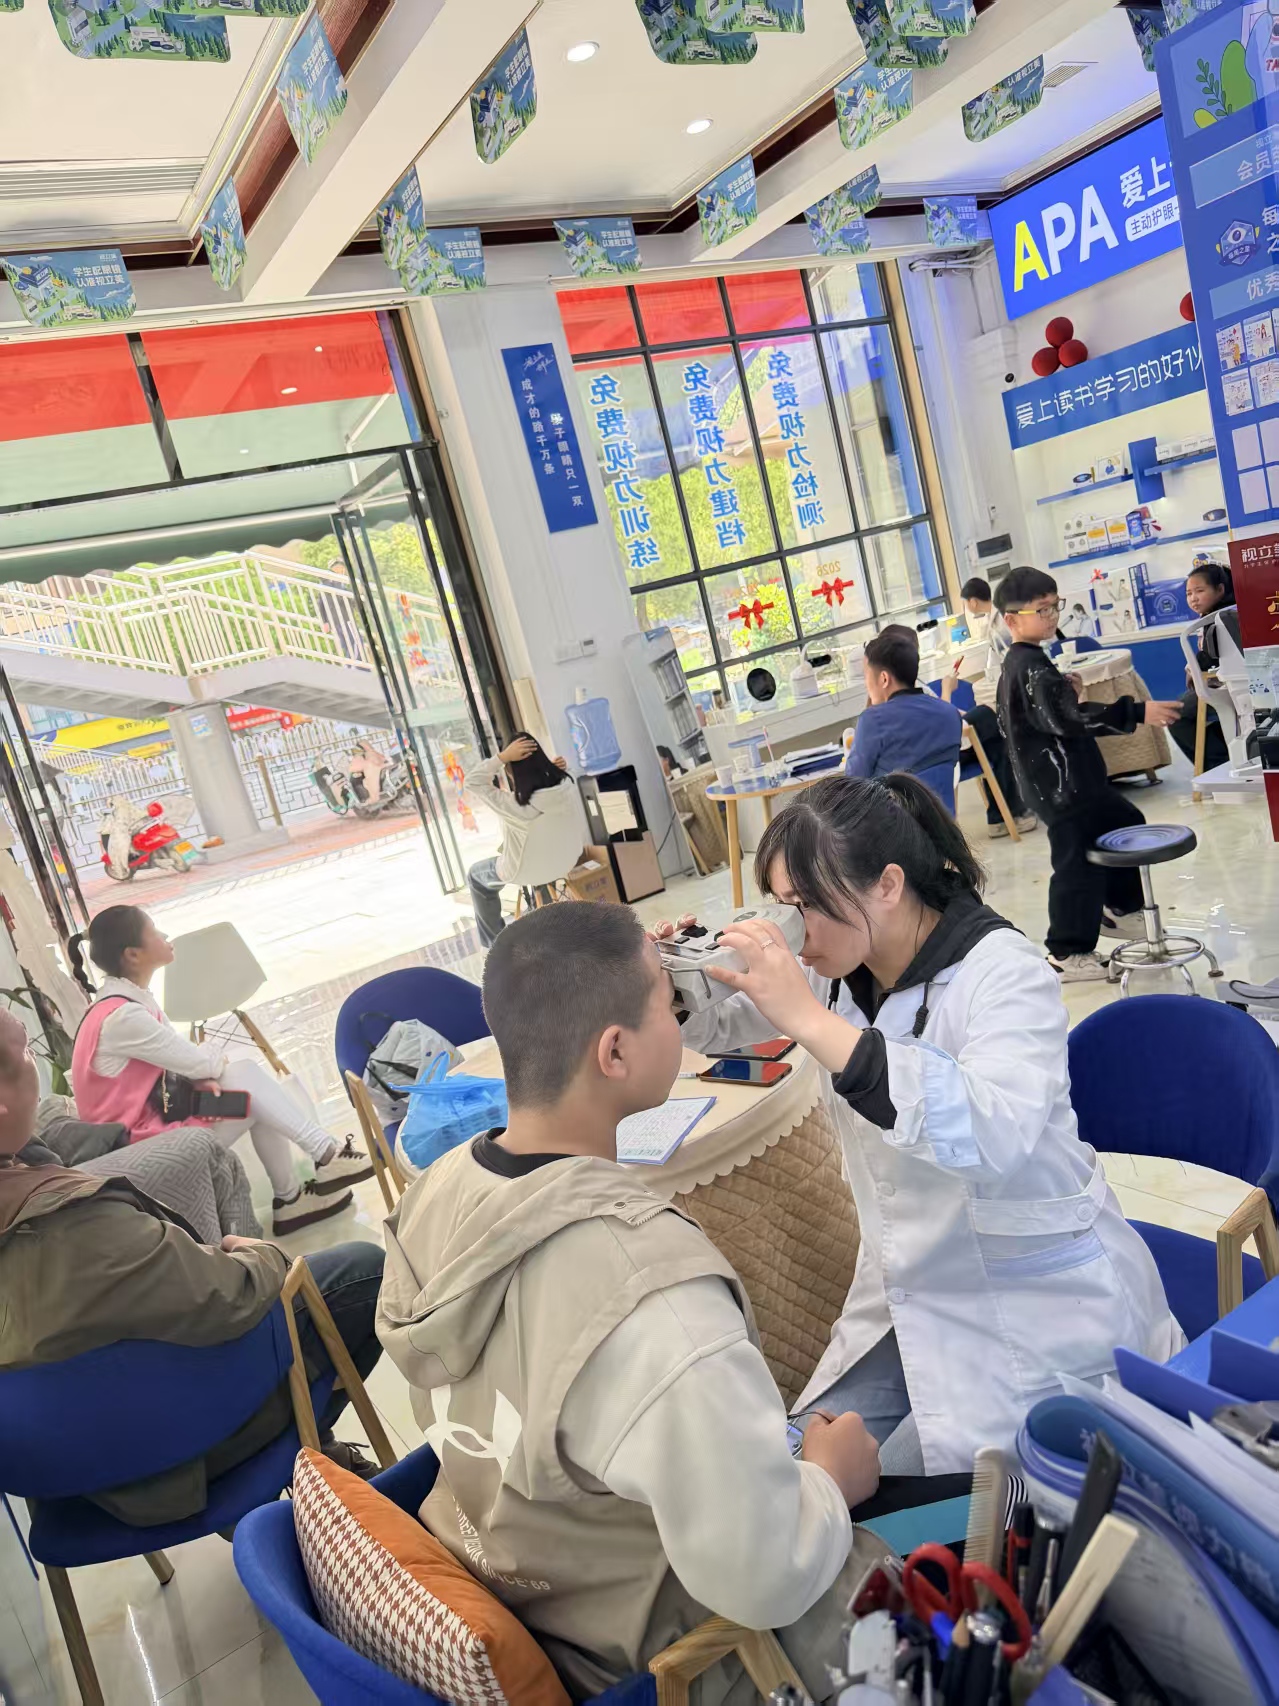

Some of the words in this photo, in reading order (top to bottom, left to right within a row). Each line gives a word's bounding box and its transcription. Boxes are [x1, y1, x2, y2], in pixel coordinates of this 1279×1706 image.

[1119, 156, 1172, 209] 爱上
[1131, 202, 1180, 236] 主动护眼
[1013, 185, 1119, 292] APA
[522, 378, 555, 475] 成才的路千万条
